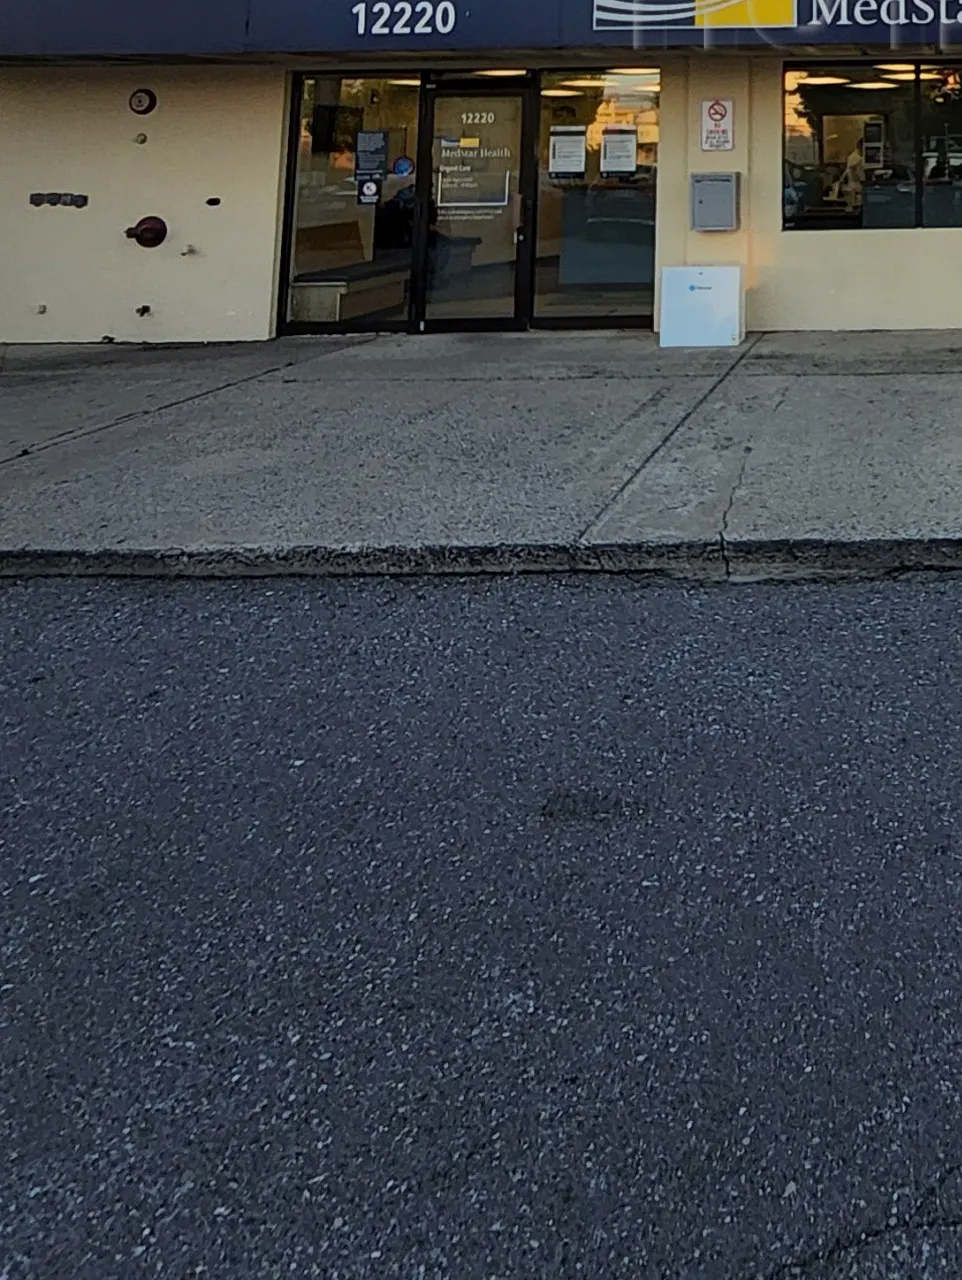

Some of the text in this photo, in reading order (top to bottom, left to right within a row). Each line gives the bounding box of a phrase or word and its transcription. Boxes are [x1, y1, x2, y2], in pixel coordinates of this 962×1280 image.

[351, 0, 456, 35] 12220
[461, 112, 495, 125] 12220
[480, 147, 511, 158] Health
